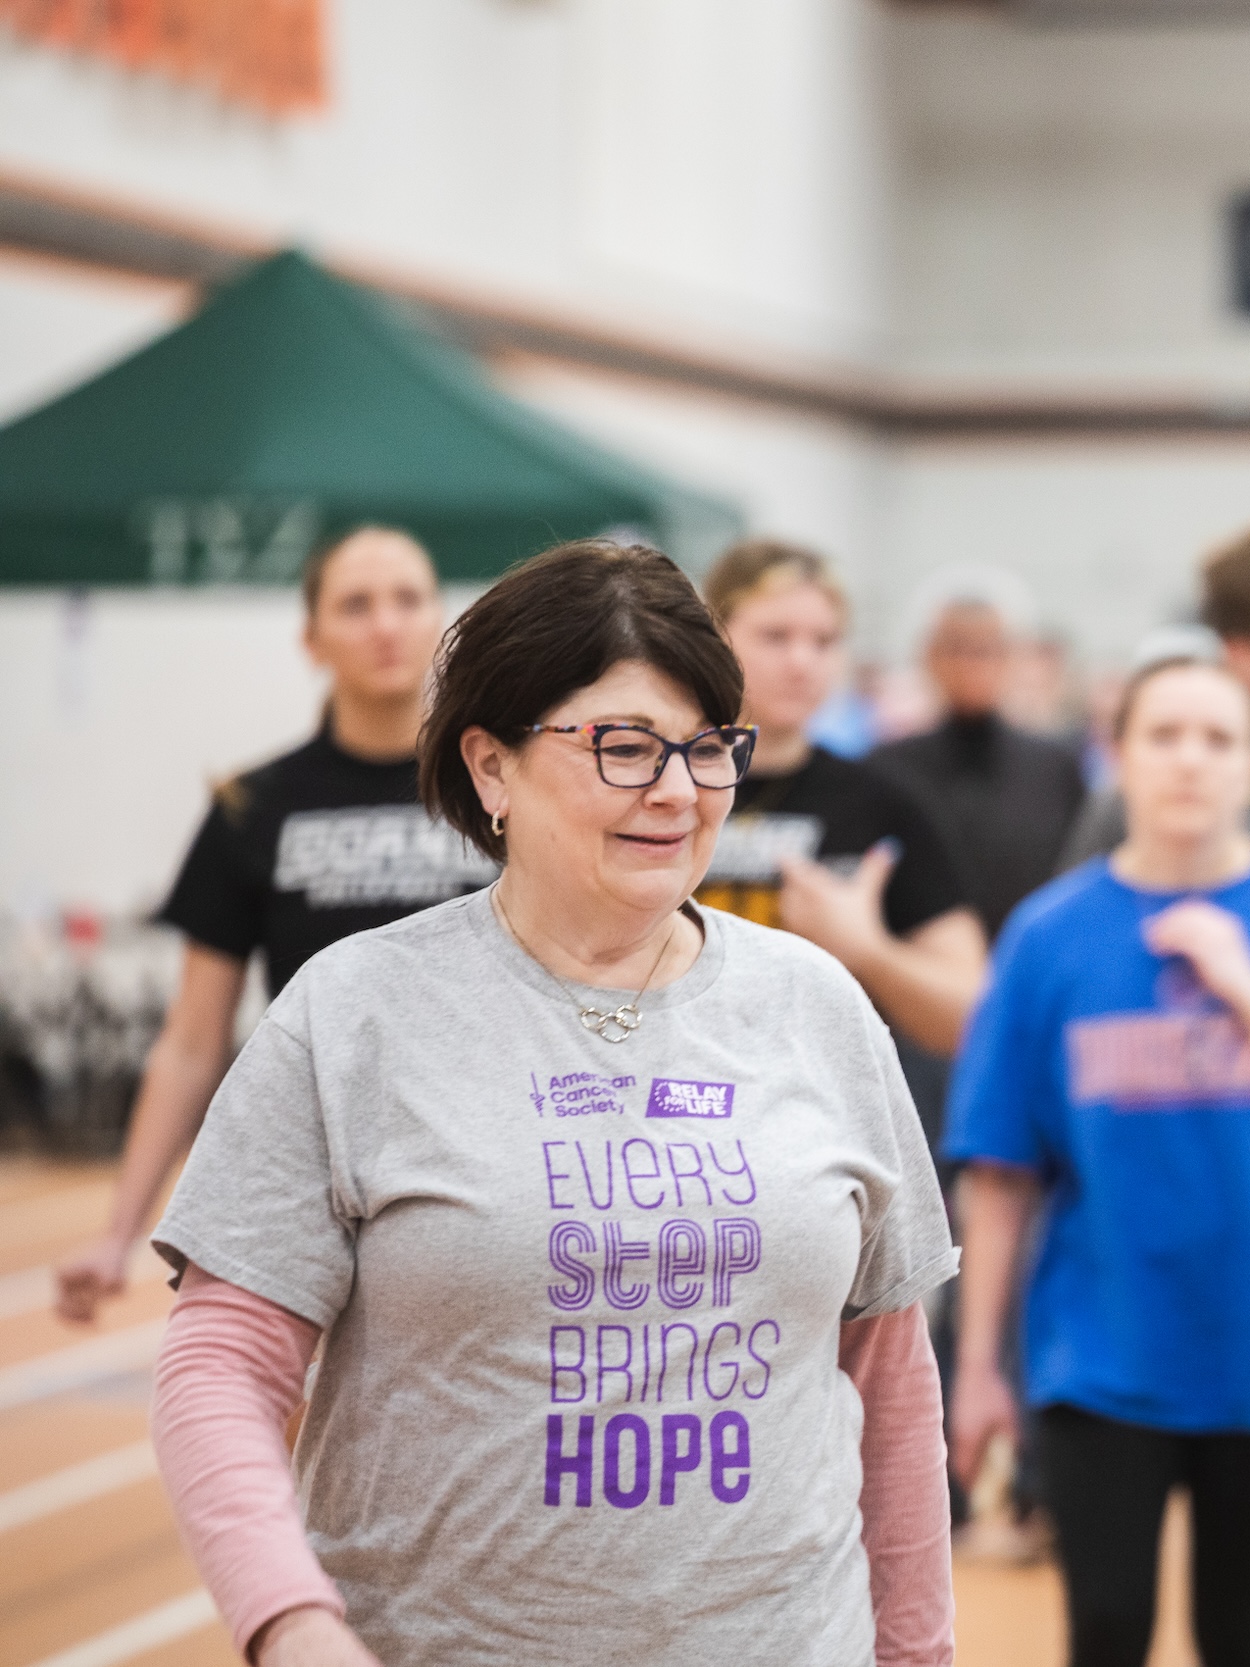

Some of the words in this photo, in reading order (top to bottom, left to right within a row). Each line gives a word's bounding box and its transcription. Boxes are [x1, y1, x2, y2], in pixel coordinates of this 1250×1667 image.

[549, 1072, 636, 1090] Ameran
[550, 1086, 616, 1103] Canc
[668, 1082, 728, 1100] RELAY
[684, 1099, 727, 1115] LIFE
